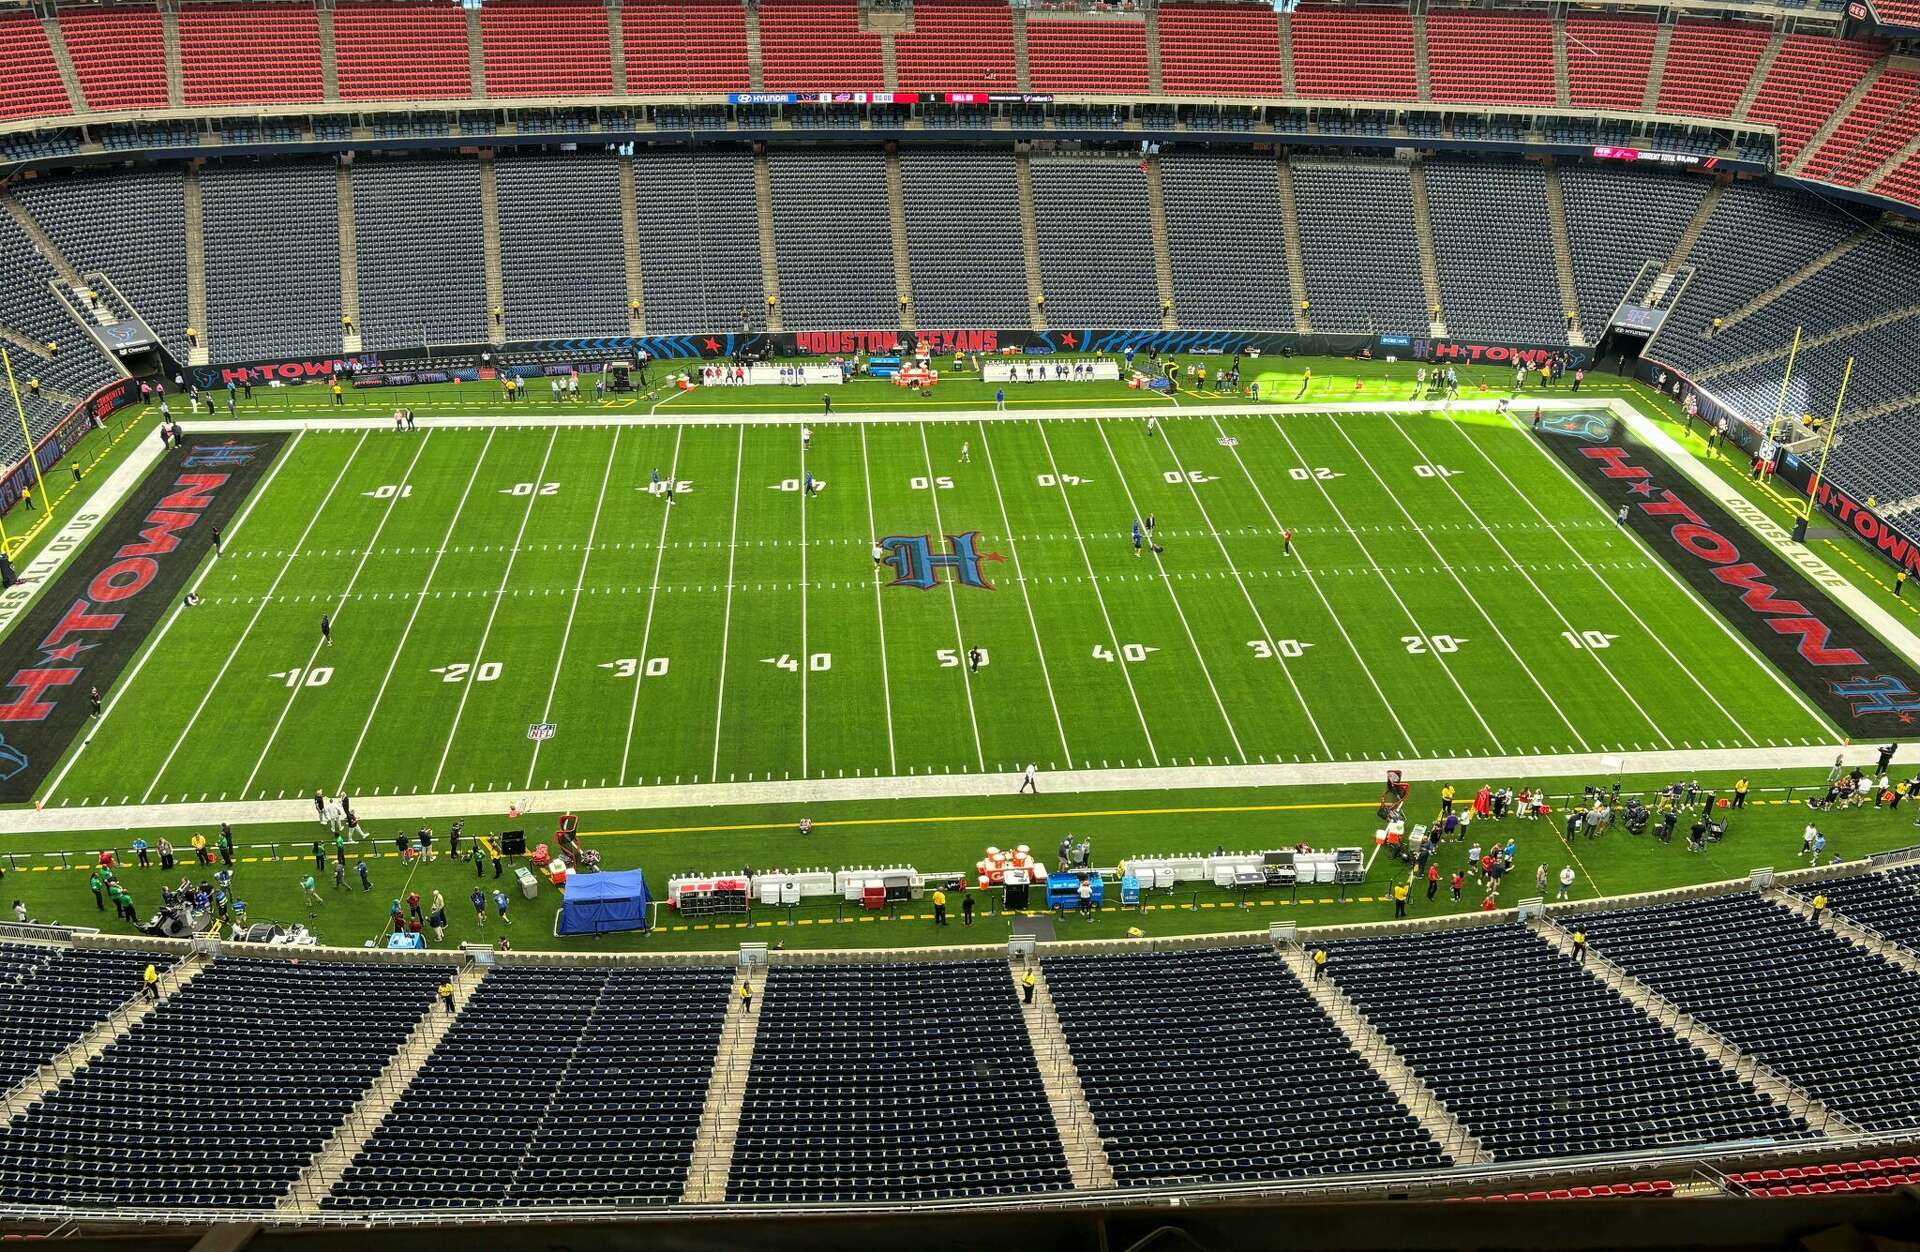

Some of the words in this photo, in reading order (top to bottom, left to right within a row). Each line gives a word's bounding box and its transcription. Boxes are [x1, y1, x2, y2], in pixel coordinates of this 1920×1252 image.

[753, 94, 789, 102] HYUNDAI
[796, 331, 898, 354] HOUSTON
[914, 330, 998, 352] TEXANS
[1037, 473, 1080, 487] 40
[1163, 471, 1208, 484] 30
[1288, 467, 1335, 480] 20
[1413, 464, 1453, 477] 10
[373, 485, 413, 498] 10
[511, 482, 560, 496] 20
[781, 478, 827, 491] 40
[911, 476, 954, 489] 50
[26, 558, 61, 584] ALL
[51, 536, 79, 552] OF
[69, 513, 99, 530] US
[1726, 498, 1793, 548] CHOOSE
[1791, 551, 1848, 588] LOVE
[1247, 639, 1303, 659] 30
[1401, 634, 1459, 654] 20
[1562, 630, 1611, 649] 10
[776, 653, 831, 672] 40
[936, 648, 990, 667] 50
[1092, 643, 1146, 663] 40
[285, 666, 335, 687] 10
[442, 662, 503, 683] 20
[613, 657, 669, 677] 30
